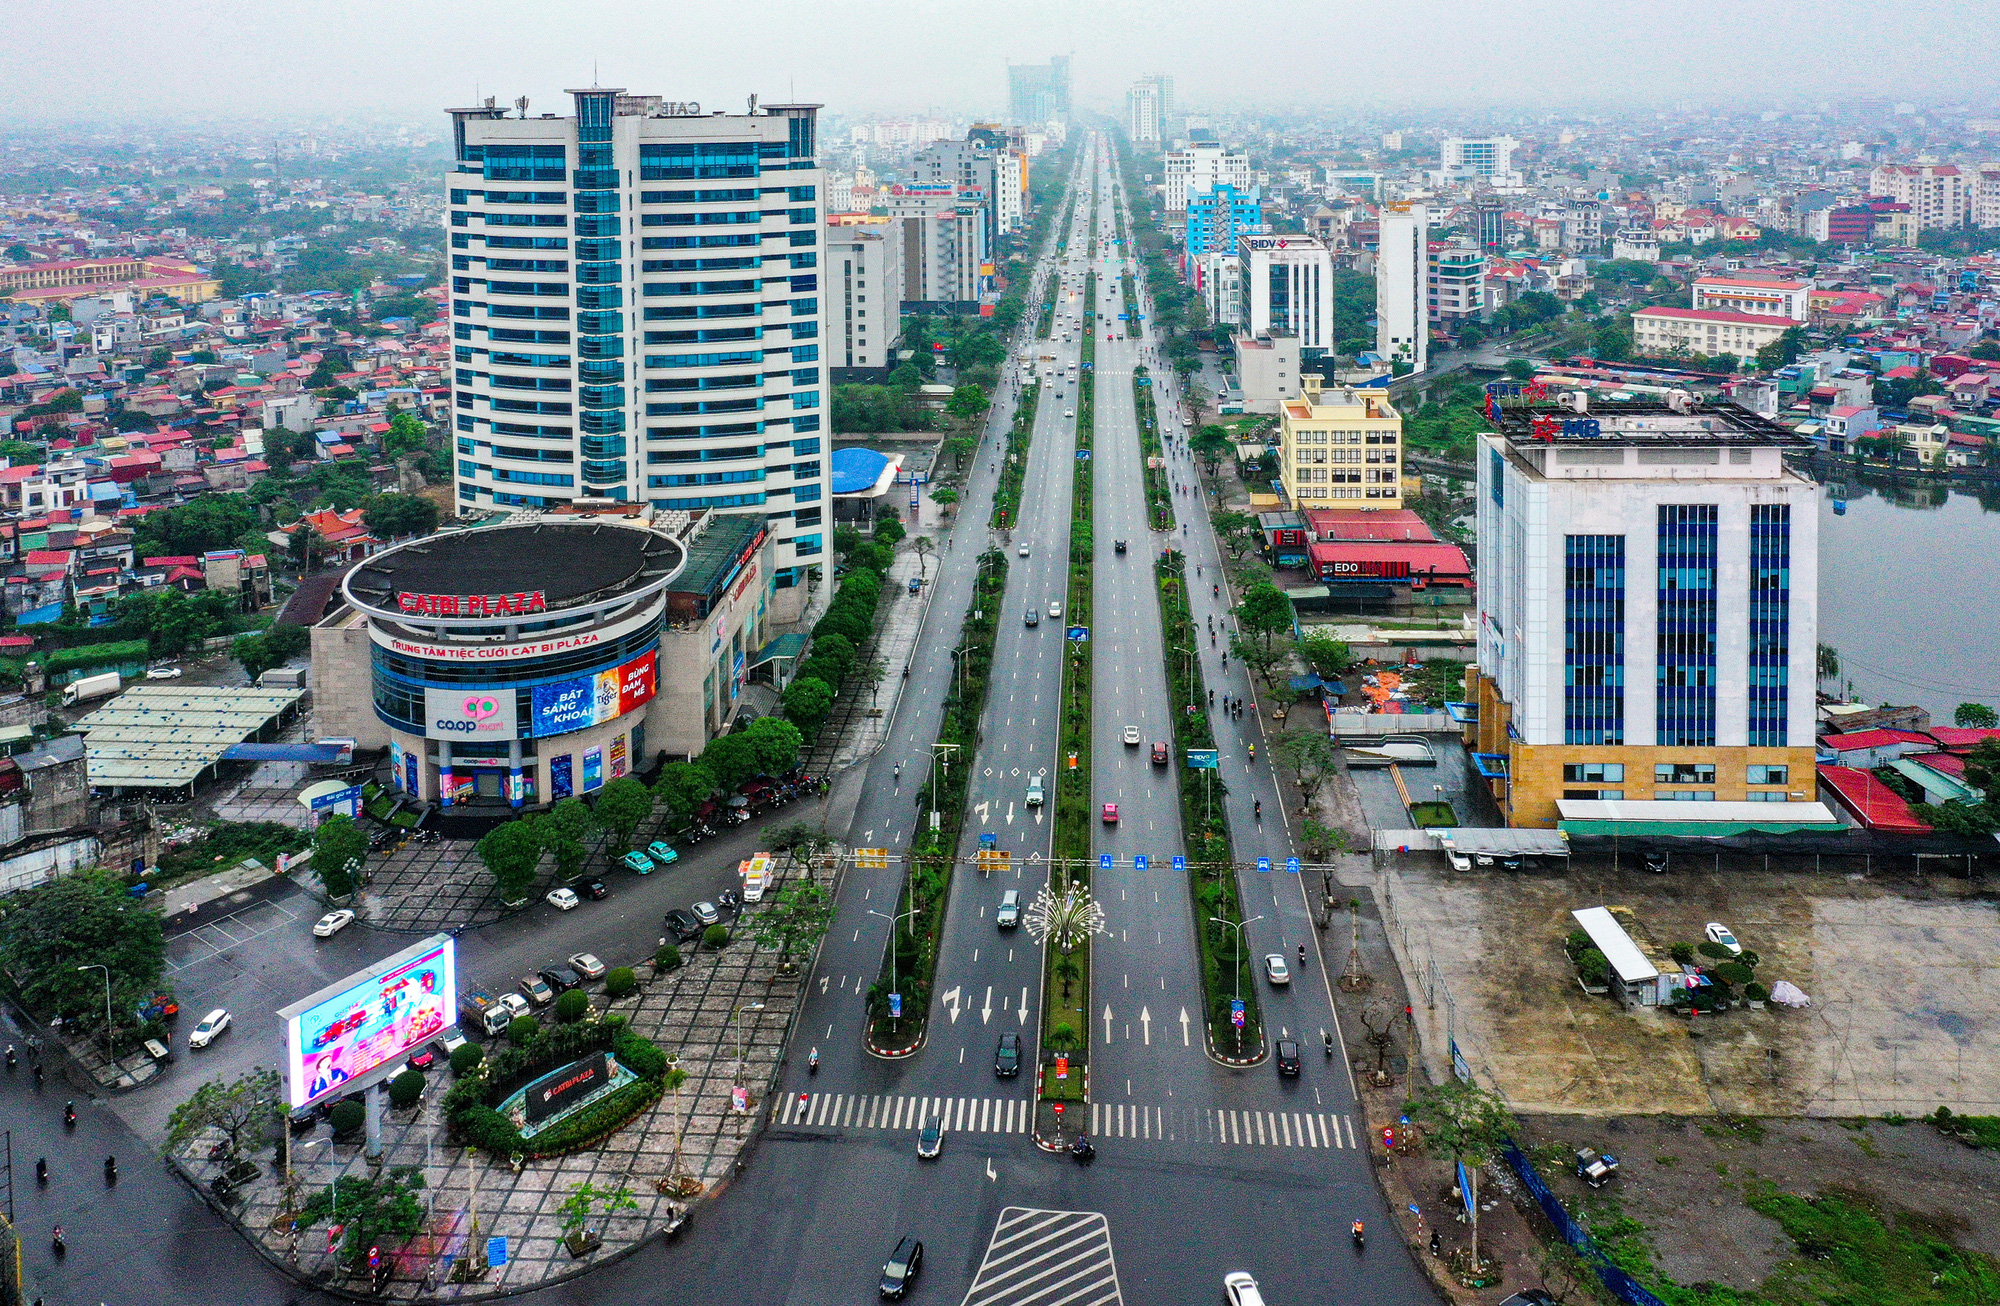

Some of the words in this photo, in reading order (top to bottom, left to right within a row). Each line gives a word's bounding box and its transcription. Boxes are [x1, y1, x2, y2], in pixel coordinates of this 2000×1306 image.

[1251, 239, 1277, 249] BIDV
[1562, 419, 1601, 438] MB
[1334, 562, 1359, 573] EDO
[397, 591, 460, 615] CATBI
[467, 590, 546, 615] PLAZA
[390, 639, 421, 655] TRUNG
[423, 646, 446, 658] TÂM
[448, 647, 475, 660] TIỆC
[511, 645, 537, 656] CAT
[541, 643, 554, 653] BI
[556, 634, 599, 649] PLAZA
[627, 663, 650, 682] BÙNG
[621, 678, 642, 694] ĐAM
[633, 684, 646, 699] MÊ
[596, 691, 618, 706] Tiger
[553, 706, 593, 724] KHOÁI
[572, 1068, 595, 1085] PLAZA
